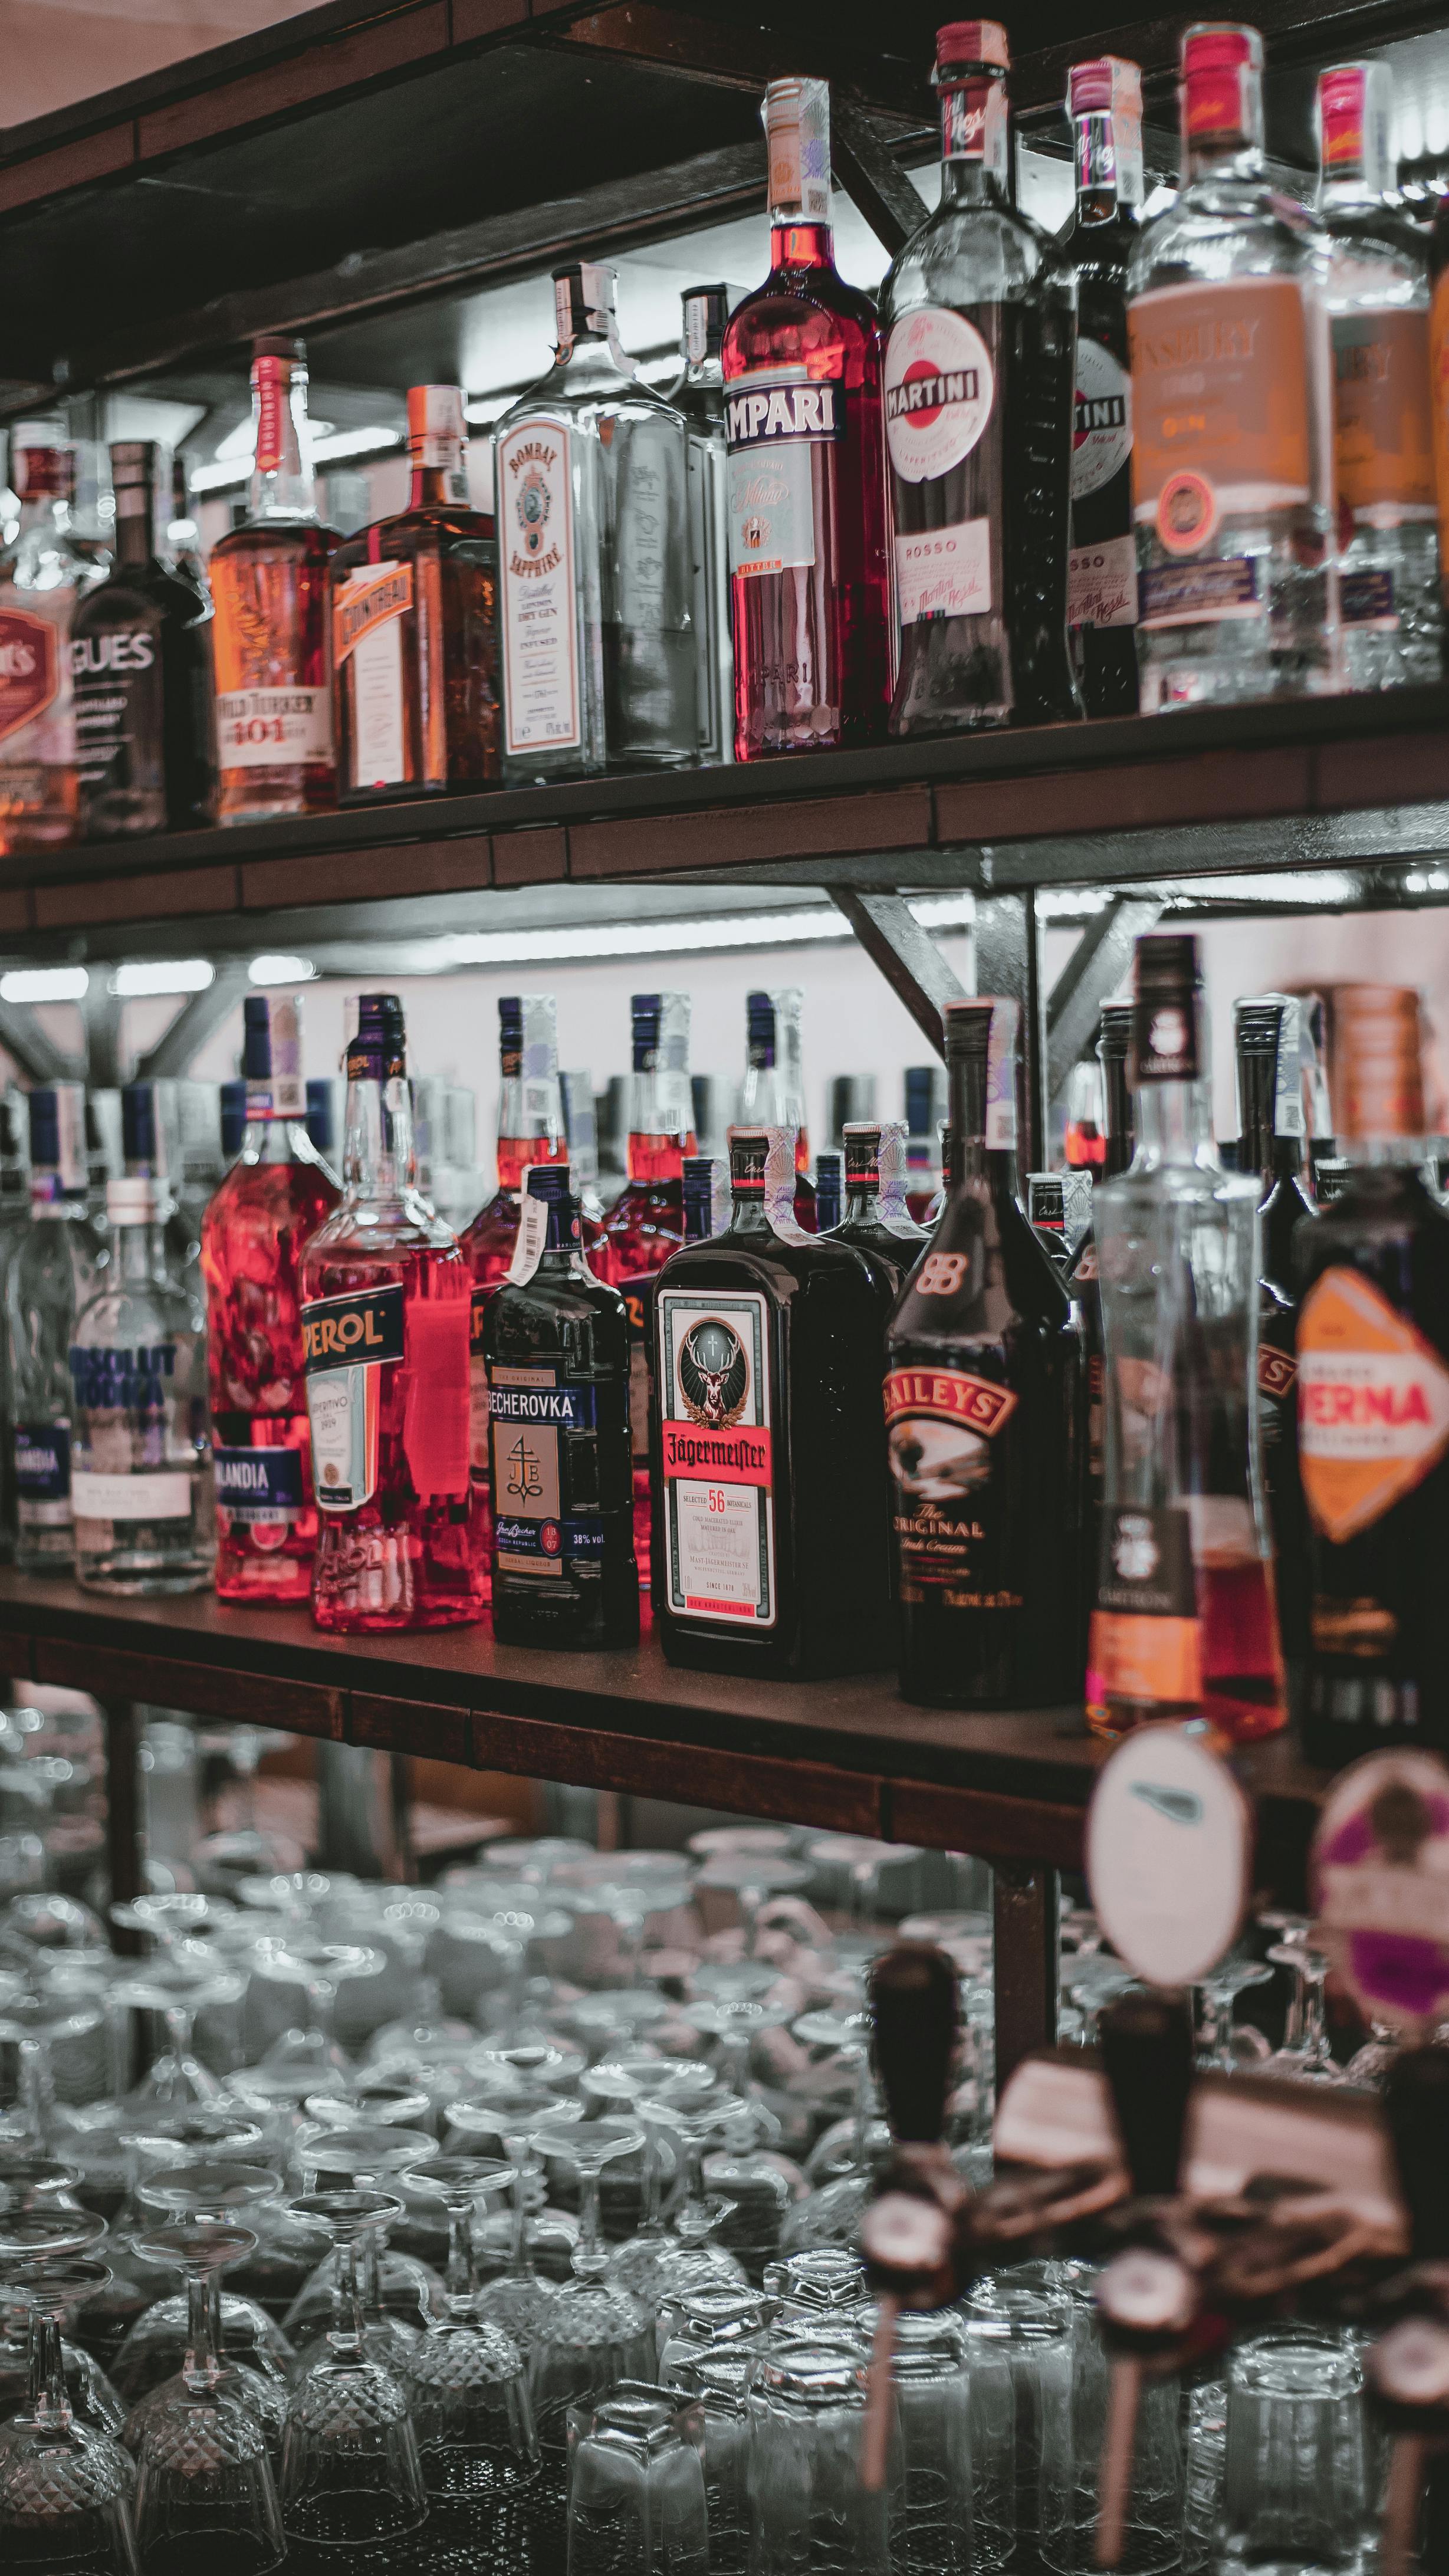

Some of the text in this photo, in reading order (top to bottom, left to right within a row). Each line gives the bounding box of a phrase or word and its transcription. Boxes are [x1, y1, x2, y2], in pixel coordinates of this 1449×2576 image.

[888, 372, 975, 418] MARTINI
[727, 387, 834, 442] MPARI
[510, 443, 558, 479] BOMBAY
[906, 540, 957, 560] ROSSO
[510, 543, 561, 579] SAPPHIRE
[741, 560, 777, 573] BITTER
[234, 716, 286, 746] 101
[488, 1390, 574, 1417] BECHEROVKA
[668, 1432, 765, 1471] Jägermeister
[684, 1489, 751, 1513] SELECTED 56 BOTANICALS
[913, 1503, 945, 1519] The
[496, 1522, 537, 1537] Jan Becher
[546, 1527, 556, 1536] 18
[701, 1524, 721, 1532] MATURED
[893, 1516, 985, 1539] ORIGINAL
[546, 1541, 557, 1549] 07
[573, 1534, 605, 1544] 38% vol.
[707, 1582, 734, 1592] SINCE 1878
